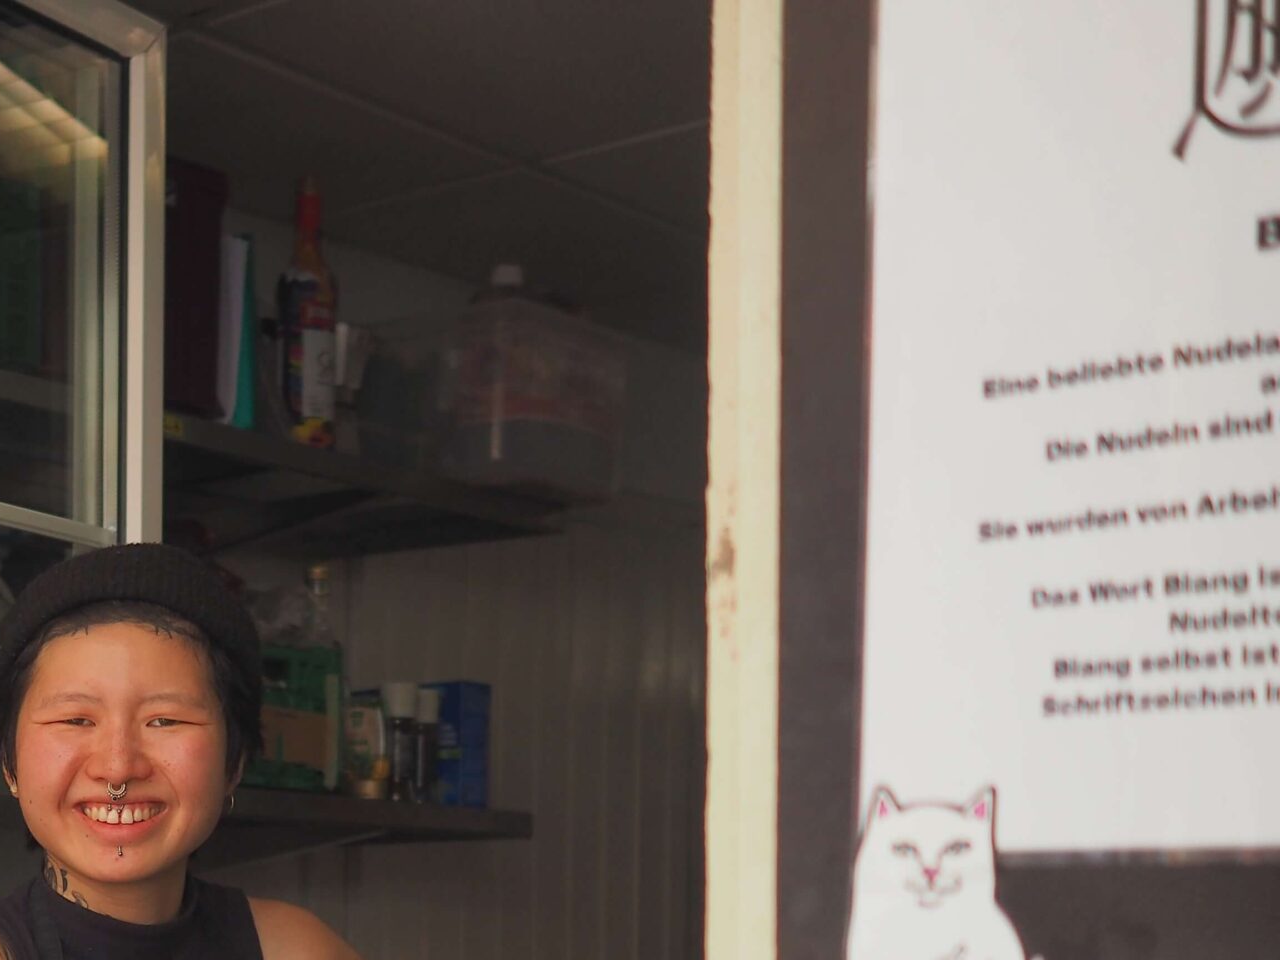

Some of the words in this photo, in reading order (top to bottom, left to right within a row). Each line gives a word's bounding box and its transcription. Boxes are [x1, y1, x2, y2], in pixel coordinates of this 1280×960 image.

[983, 376, 1040, 400] Eine
[1046, 352, 1165, 389] beliebte
[1045, 438, 1089, 461] Die
[1096, 421, 1201, 455] Nudeln
[1207, 408, 1274, 440] sind
[978, 519, 1019, 541] Sie
[1025, 505, 1129, 537] wurden
[1136, 501, 1188, 523] von
[1030, 587, 1081, 609] Das
[1088, 576, 1154, 604] Wort
[1163, 571, 1249, 595] Biang
[1053, 656, 1132, 679] Biang
[1140, 646, 1231, 672] selbst
